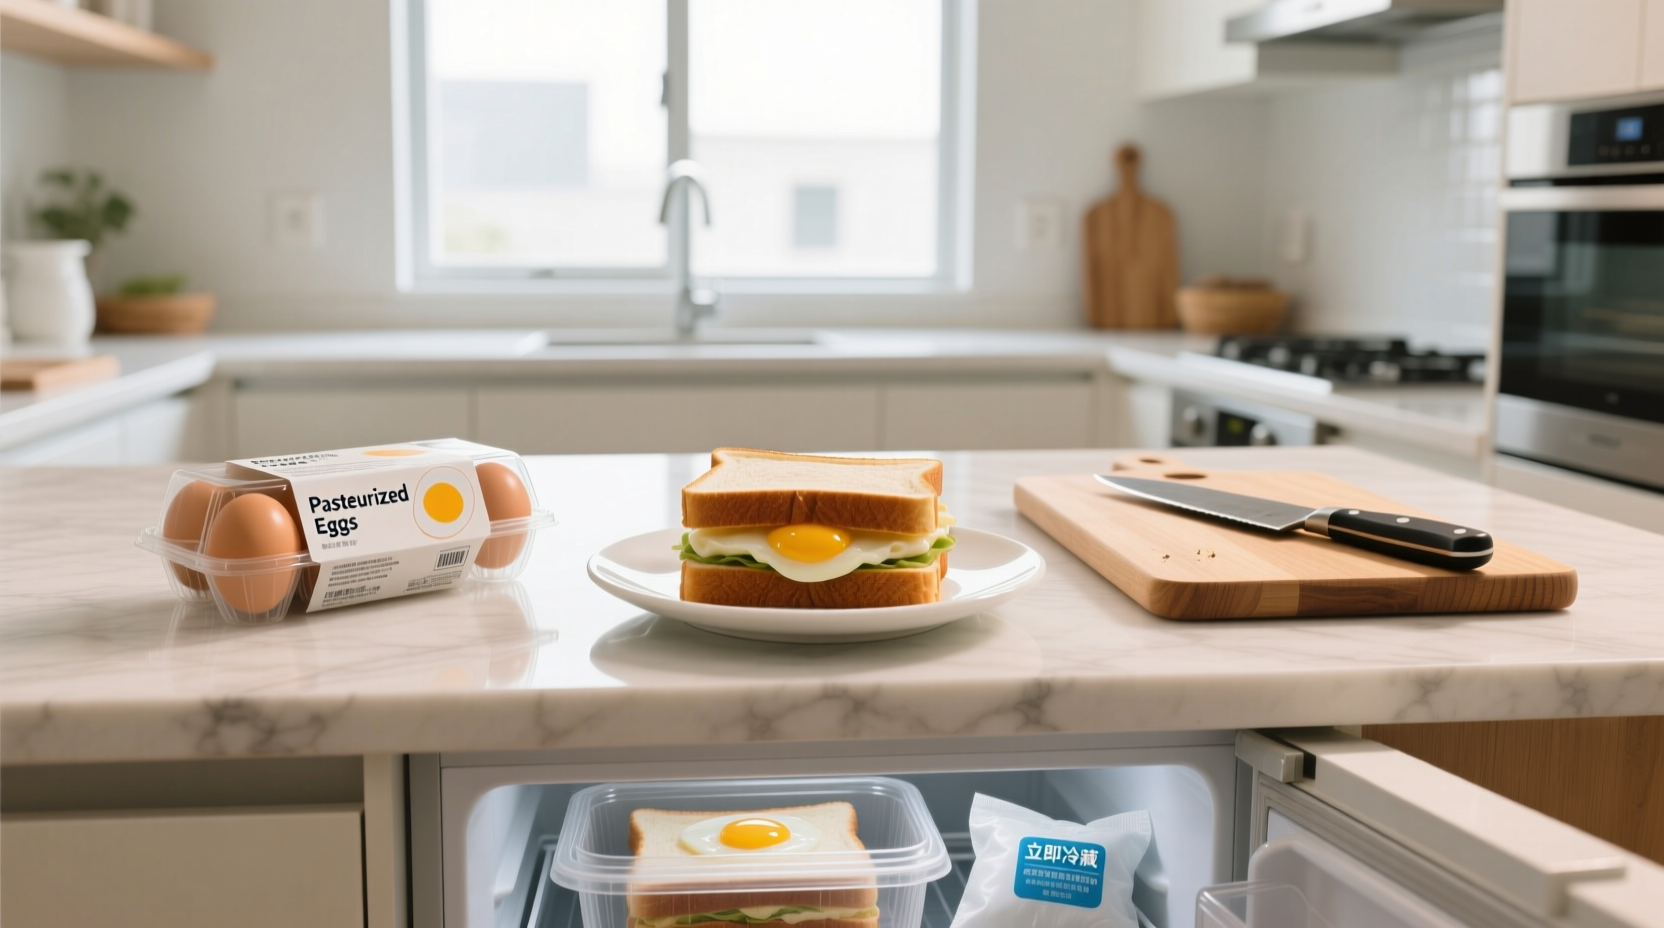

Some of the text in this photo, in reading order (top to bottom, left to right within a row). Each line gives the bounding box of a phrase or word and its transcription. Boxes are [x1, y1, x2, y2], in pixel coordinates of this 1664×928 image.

[308, 483, 410, 514] Pasteurized
[314, 516, 359, 538] Eggs
[1024, 841, 1099, 869] 立即冷藏
